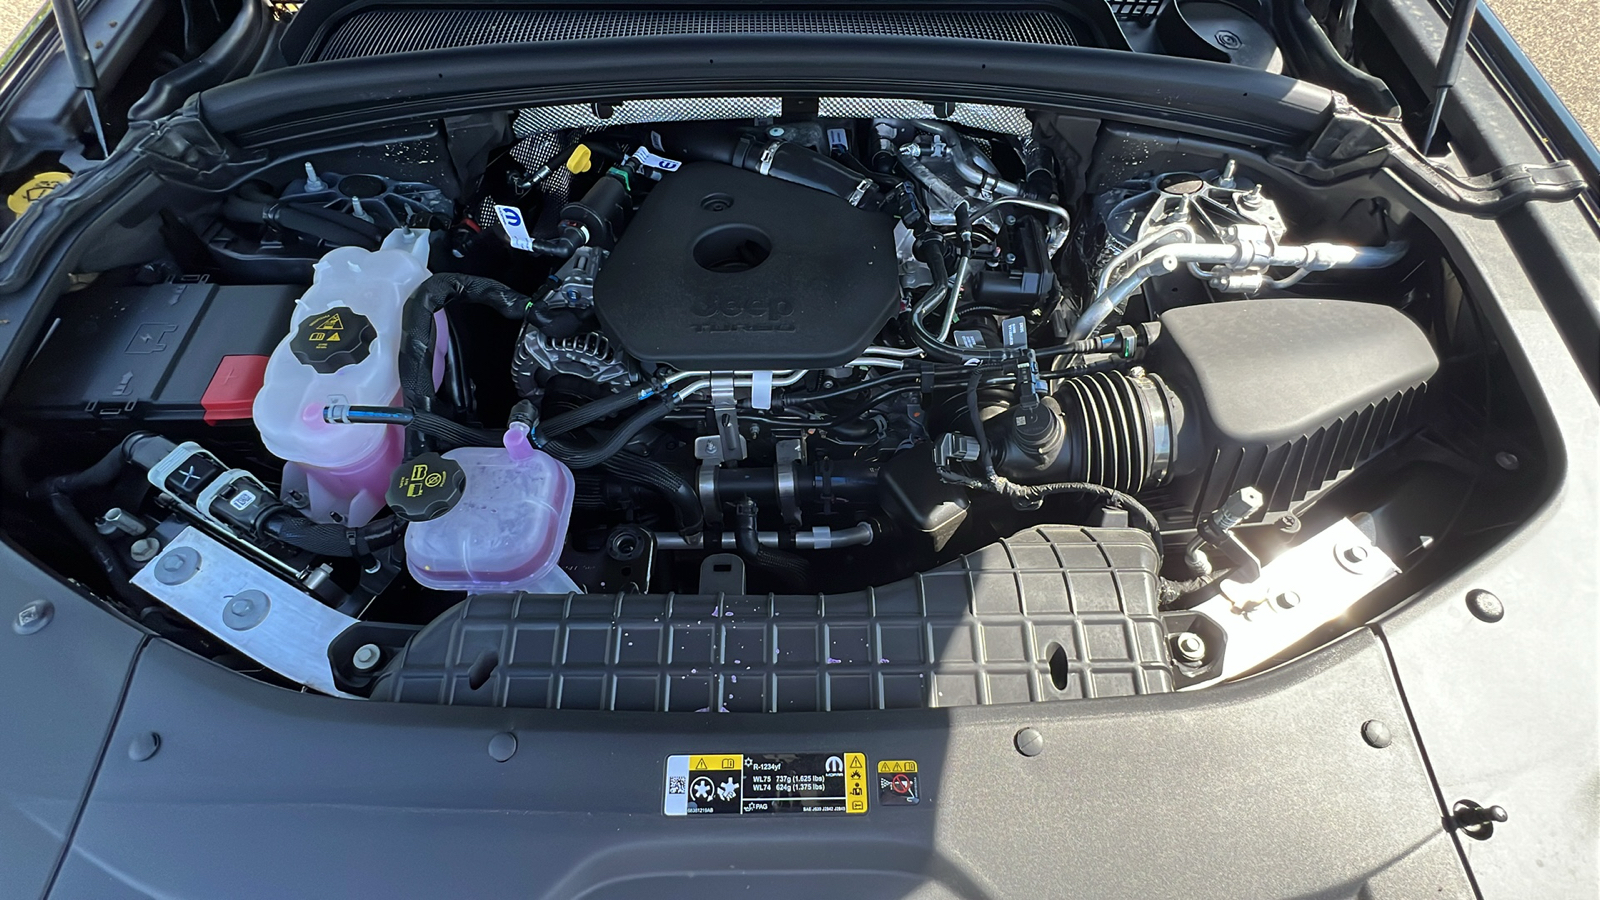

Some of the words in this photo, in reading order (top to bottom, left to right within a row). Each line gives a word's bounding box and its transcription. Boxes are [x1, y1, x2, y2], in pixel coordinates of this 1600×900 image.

[691, 290, 795, 322] Jeep
[753, 762, 782, 771] R-1234yf
[776, 775, 791, 783] 737g
[793, 775, 812, 783] (1.625
[813, 775, 825, 783] lbs)
[776, 784, 791, 792] 624g
[793, 784, 812, 792] (1.375
[813, 784, 825, 792] lbs)
